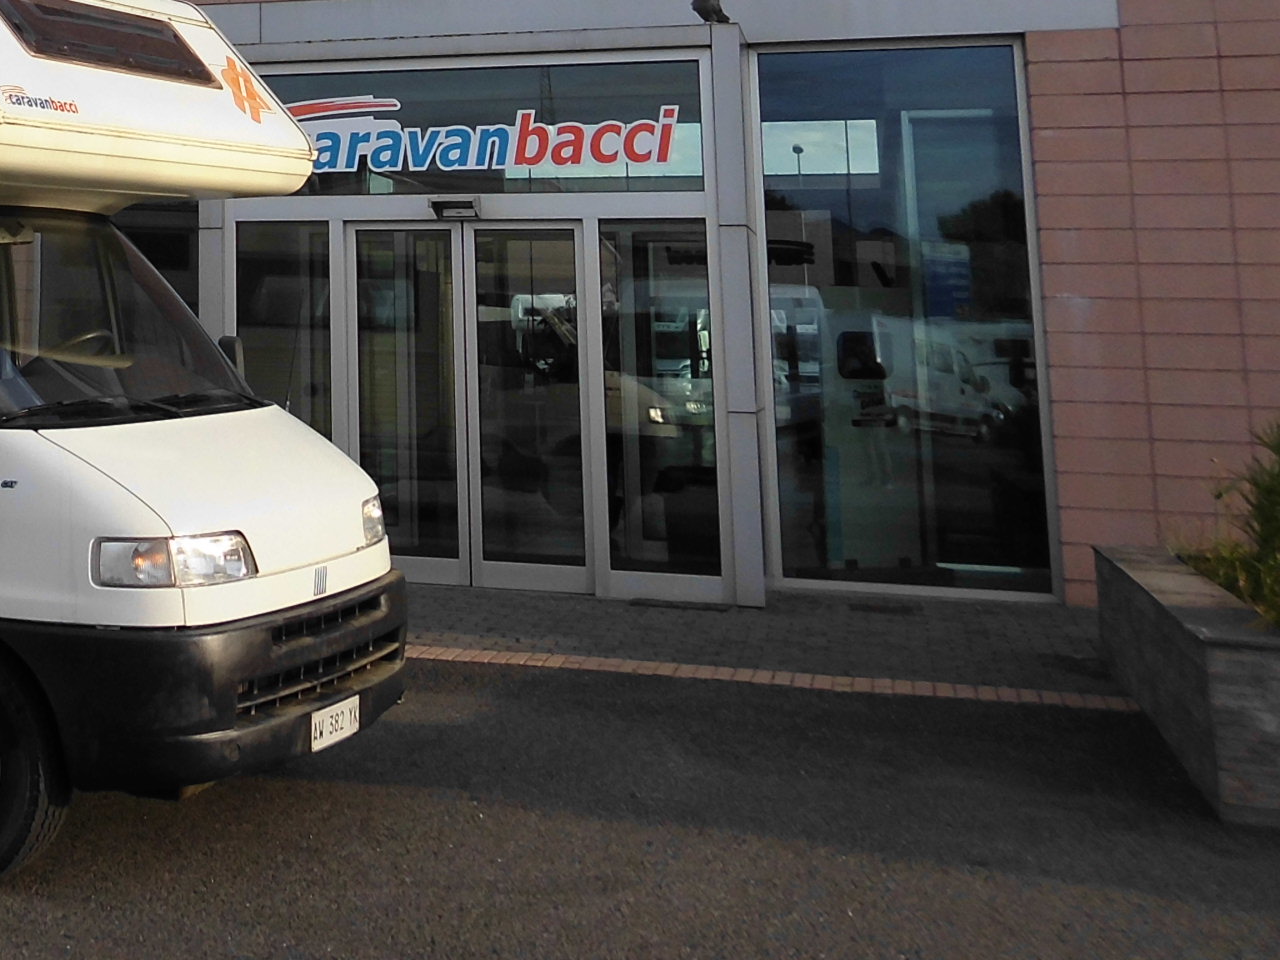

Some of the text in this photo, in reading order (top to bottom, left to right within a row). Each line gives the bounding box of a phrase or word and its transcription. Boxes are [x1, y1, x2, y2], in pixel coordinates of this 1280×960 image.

[8, 93, 79, 114] caravanbacci
[310, 107, 676, 170] aravanbacci
[329, 711, 345, 735] 382
